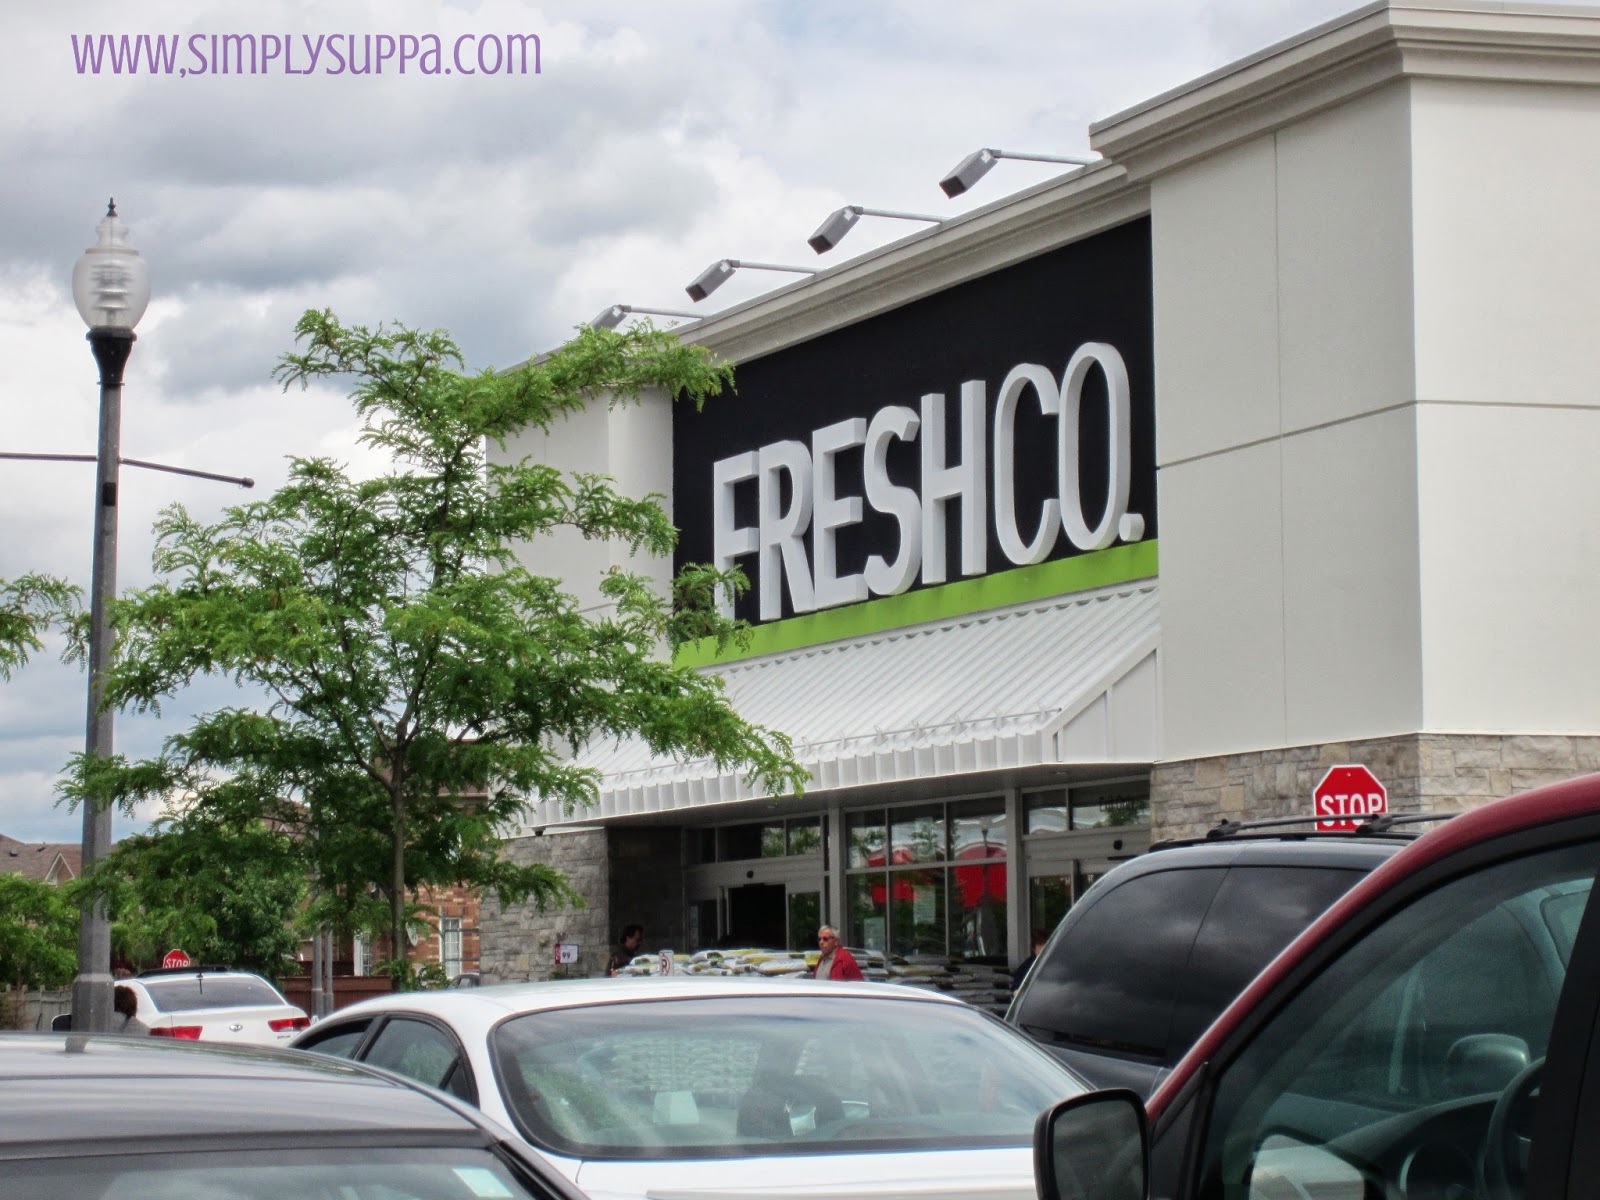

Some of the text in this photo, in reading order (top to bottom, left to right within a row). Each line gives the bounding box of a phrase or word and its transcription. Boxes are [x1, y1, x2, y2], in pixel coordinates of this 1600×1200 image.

[713, 341, 1145, 622] FRESHCO.
[1320, 793, 1383, 827] STOP
[164, 958, 189, 968] STOP
